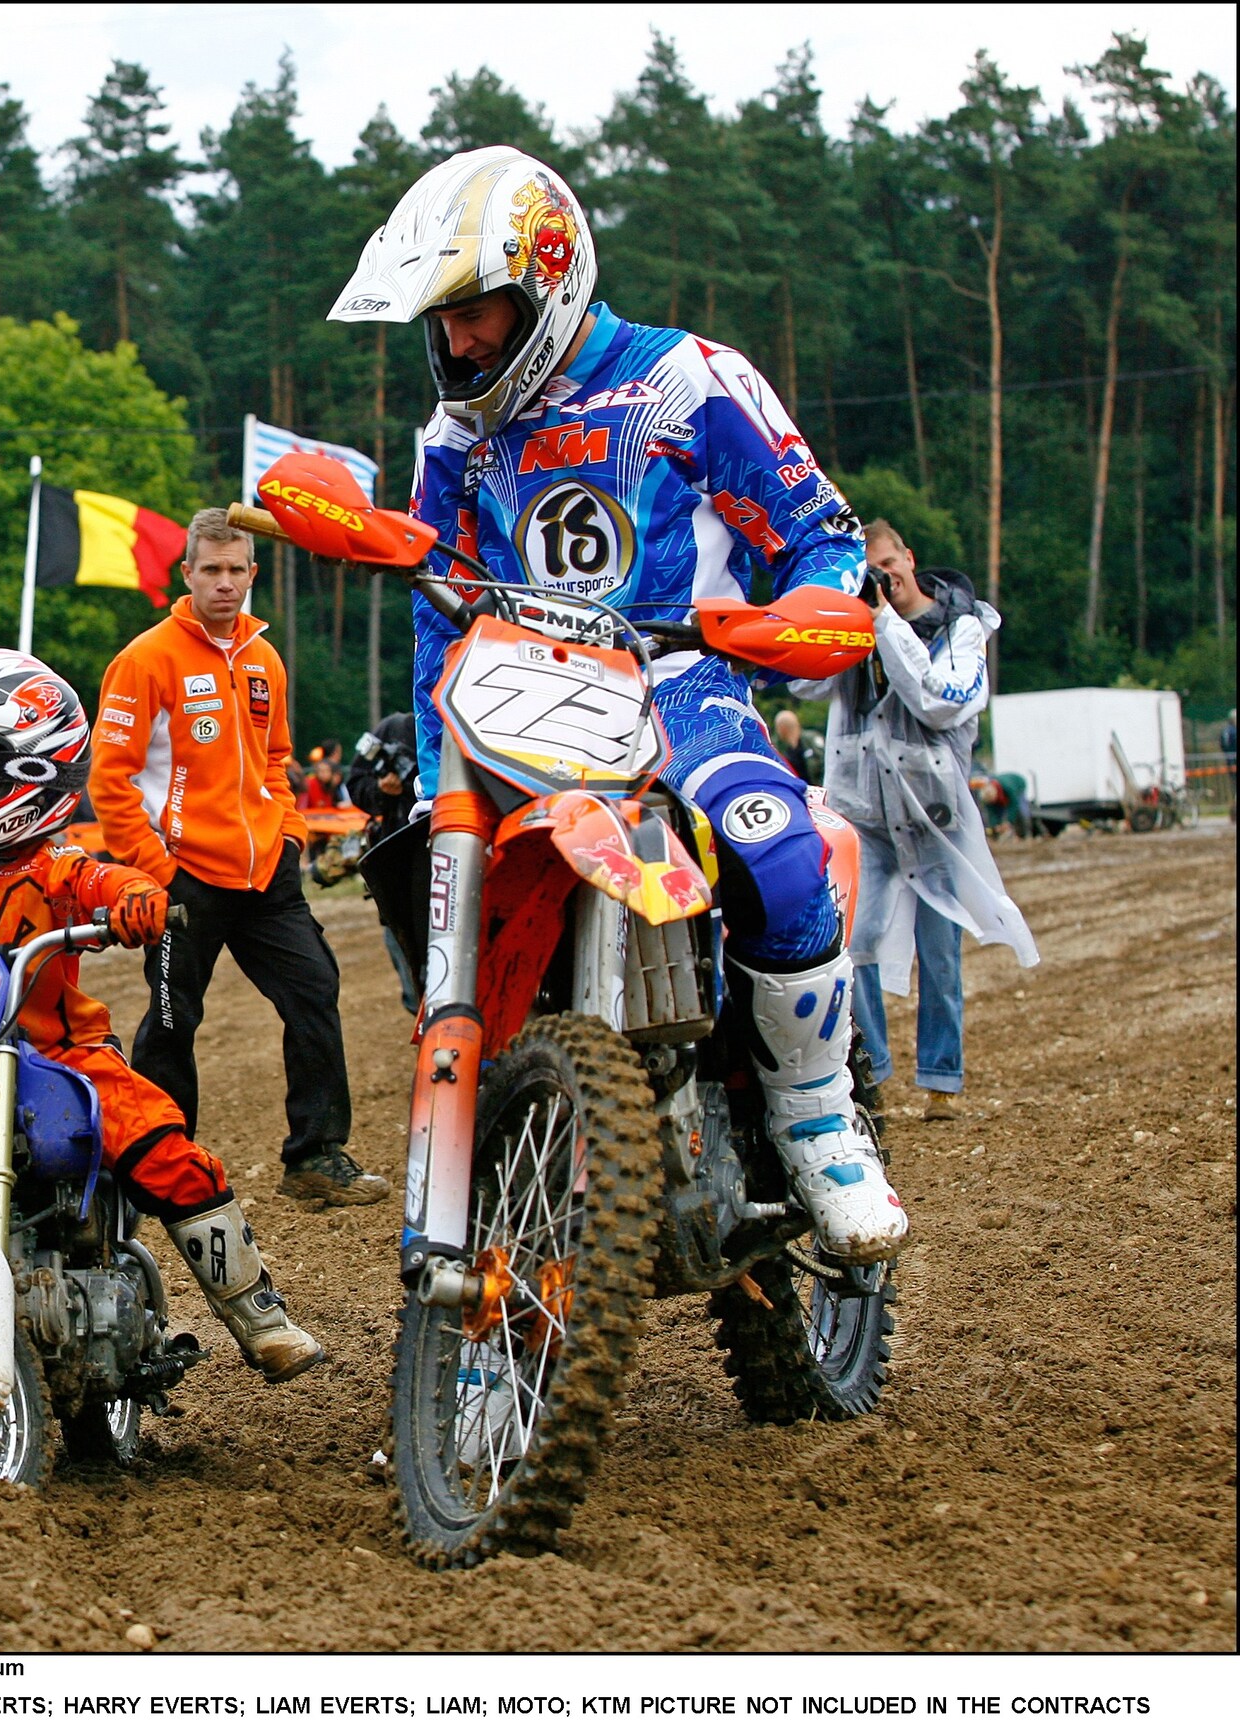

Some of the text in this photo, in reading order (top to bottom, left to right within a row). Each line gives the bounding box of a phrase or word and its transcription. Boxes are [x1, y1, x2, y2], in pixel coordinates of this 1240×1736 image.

[343, 298, 391, 312] LAZER
[519, 336, 555, 394] LAZER
[518, 421, 610, 475] KTM
[654, 421, 694, 438] LAZER
[472, 663, 647, 765] 72
